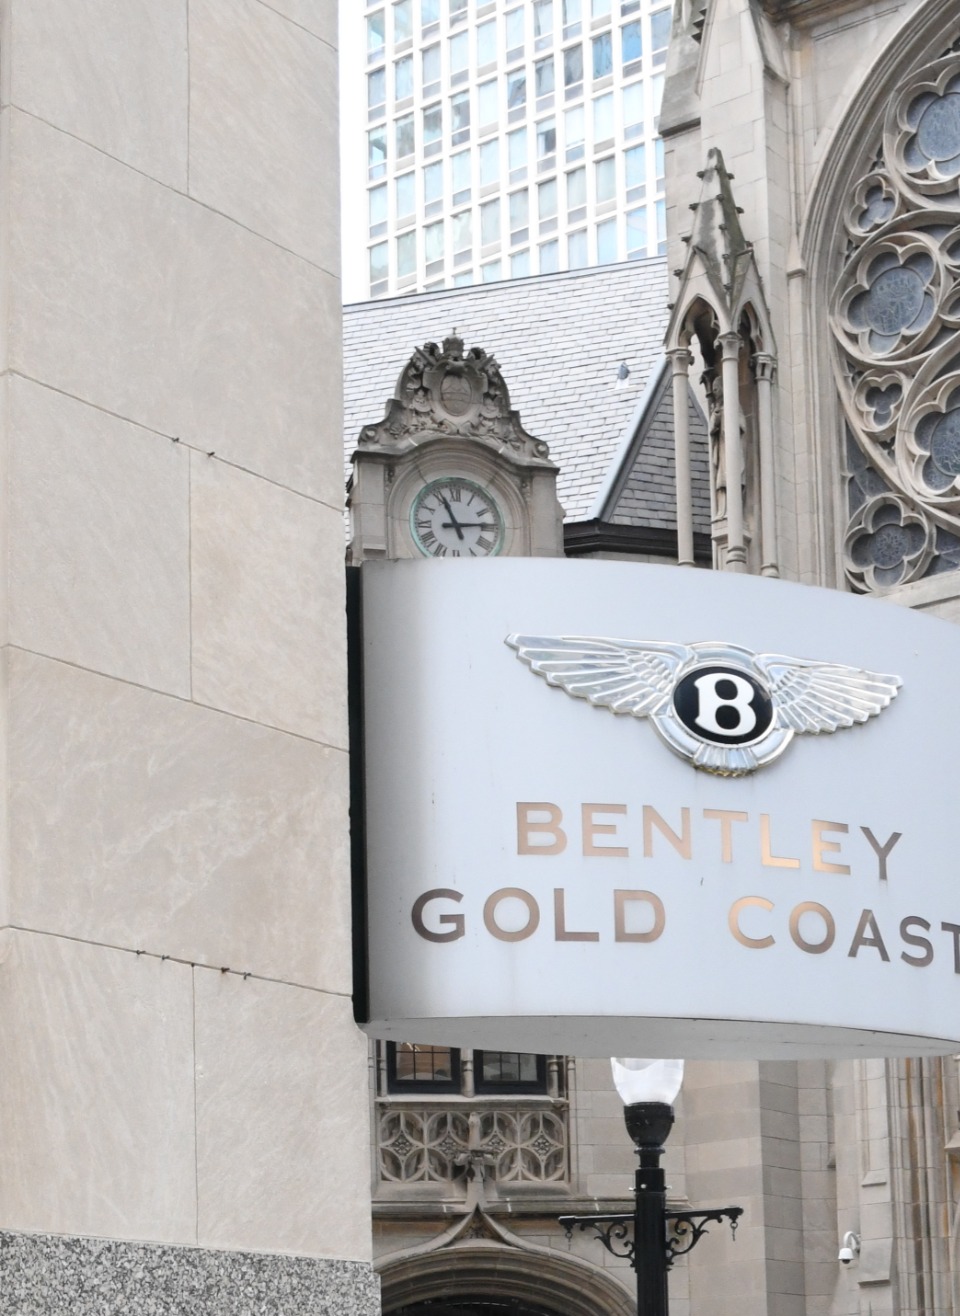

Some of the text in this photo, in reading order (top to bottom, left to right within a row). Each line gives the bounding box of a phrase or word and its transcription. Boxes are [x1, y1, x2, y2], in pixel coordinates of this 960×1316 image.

[694, 672, 757, 737] B
[515, 801, 903, 882] BENTLEY
[410, 886, 667, 944] GOLD
